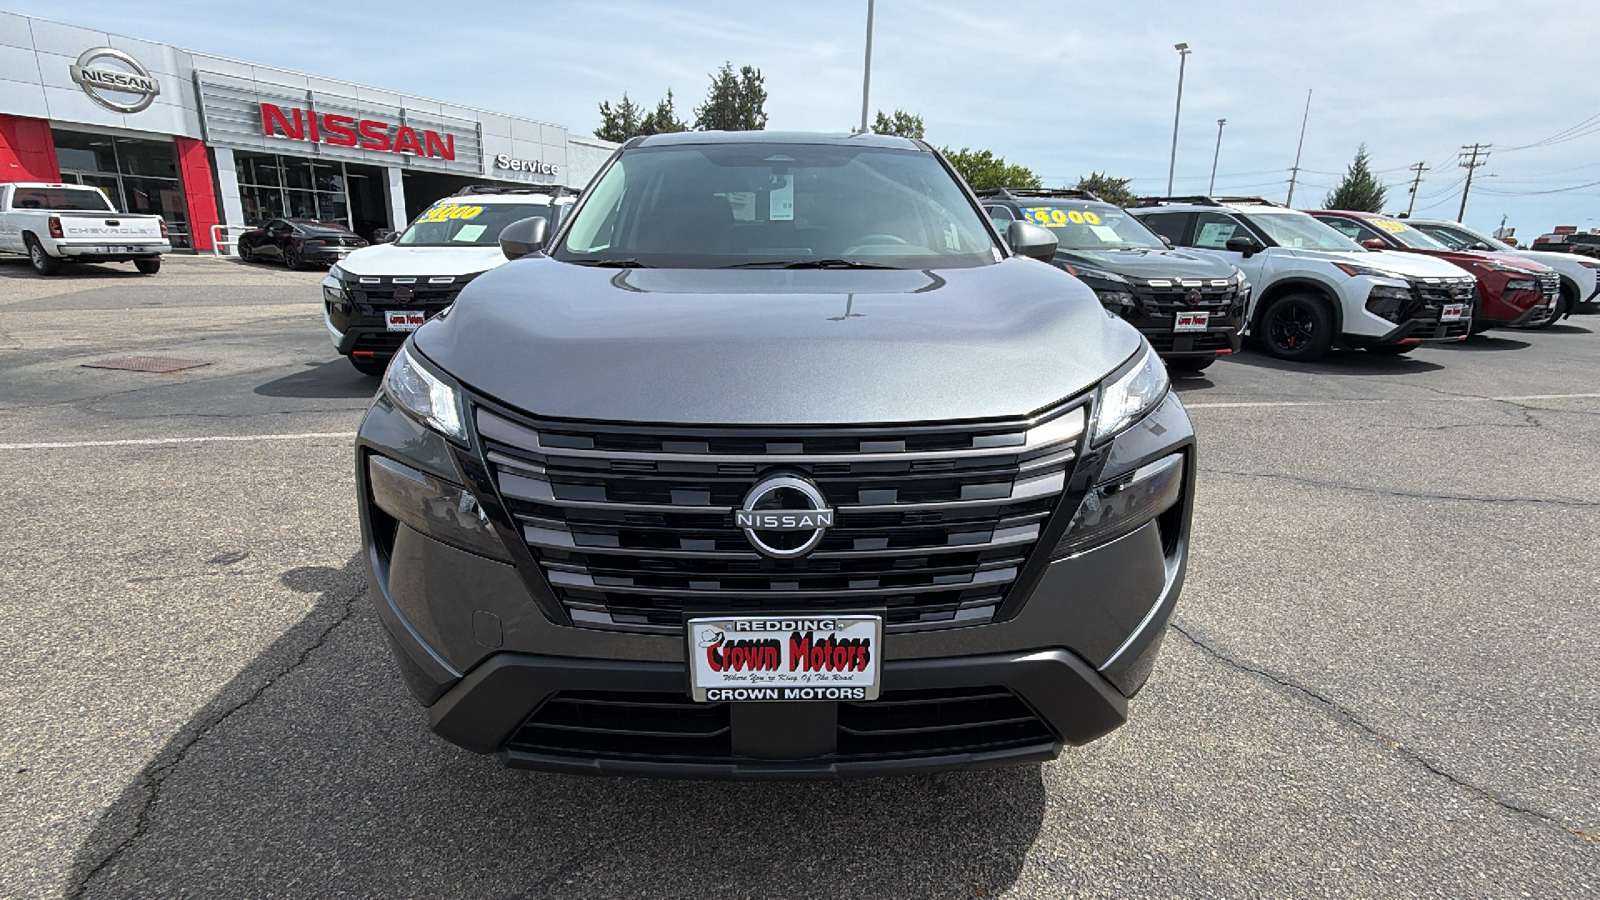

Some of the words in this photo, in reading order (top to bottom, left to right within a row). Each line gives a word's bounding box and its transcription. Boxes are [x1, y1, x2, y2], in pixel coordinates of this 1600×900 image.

[81, 69, 153, 90] NISSAN
[260, 102, 456, 160] NISSAN
[497, 153, 560, 176] Service
[737, 512, 832, 528] NISSAN
[735, 620, 835, 631] REDDING
[706, 632, 782, 672] Crown
[789, 631, 871, 672] Motors
[723, 673, 748, 681] Where
[778, 673, 798, 683] King
[801, 673, 812, 683] Of
[814, 673, 829, 682] The
[831, 674, 854, 682] Road
[707, 688, 779, 701] CROWN
[784, 687, 865, 700] MOTORS
